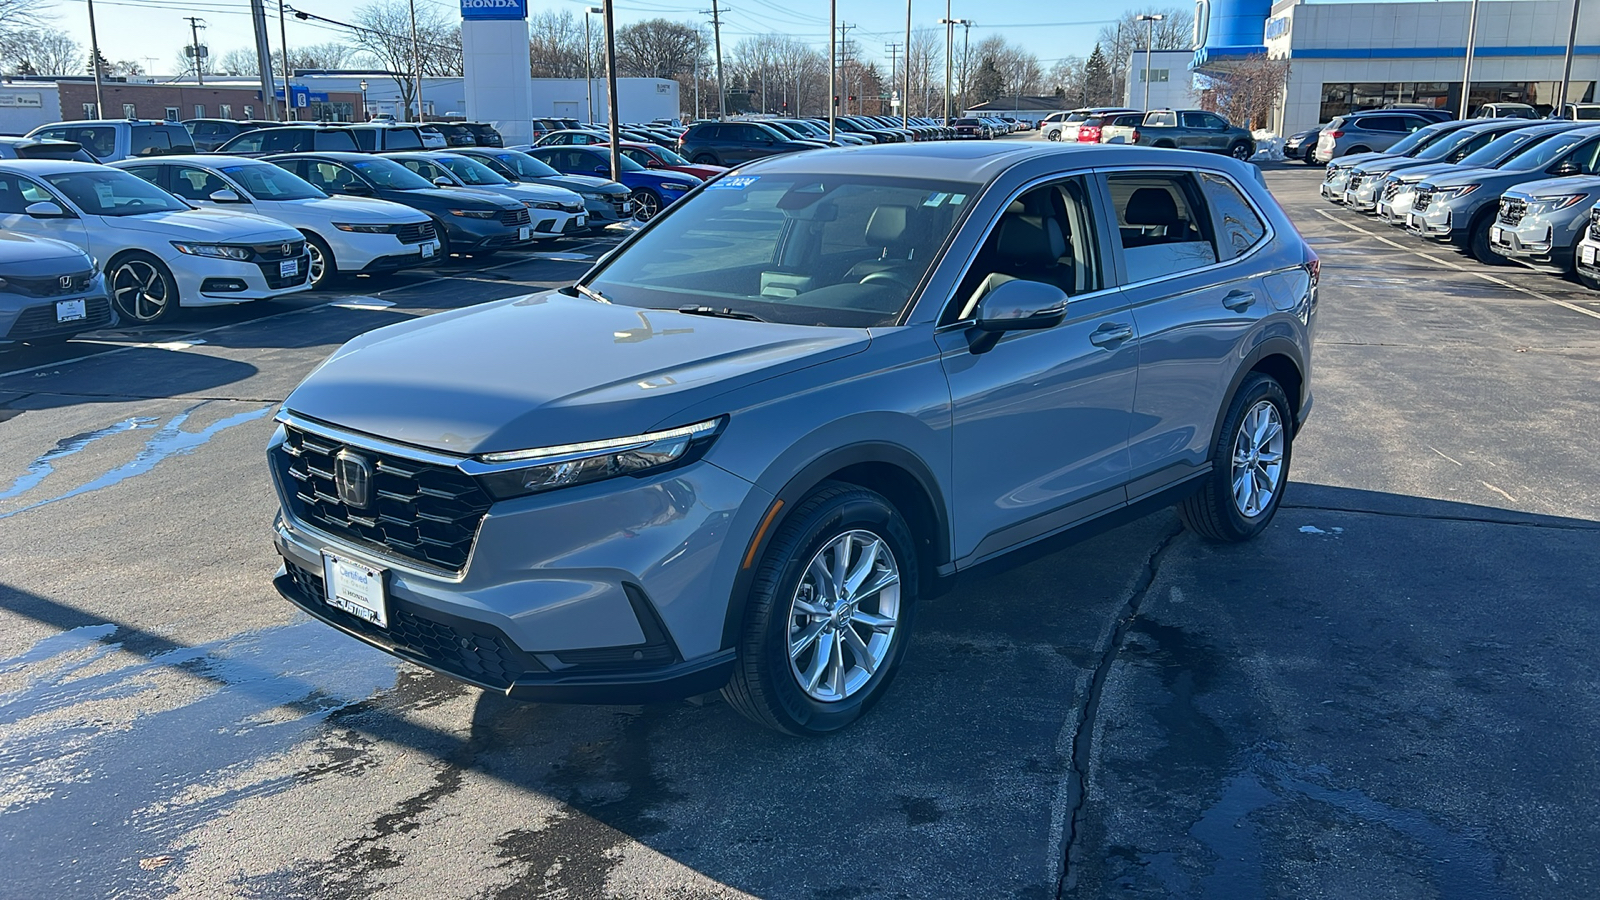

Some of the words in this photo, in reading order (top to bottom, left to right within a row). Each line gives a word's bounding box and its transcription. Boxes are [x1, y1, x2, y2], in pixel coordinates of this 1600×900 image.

[462, 0, 519, 8] HONDA
[340, 566, 367, 584] Certified
[347, 591, 369, 603] HONDA
